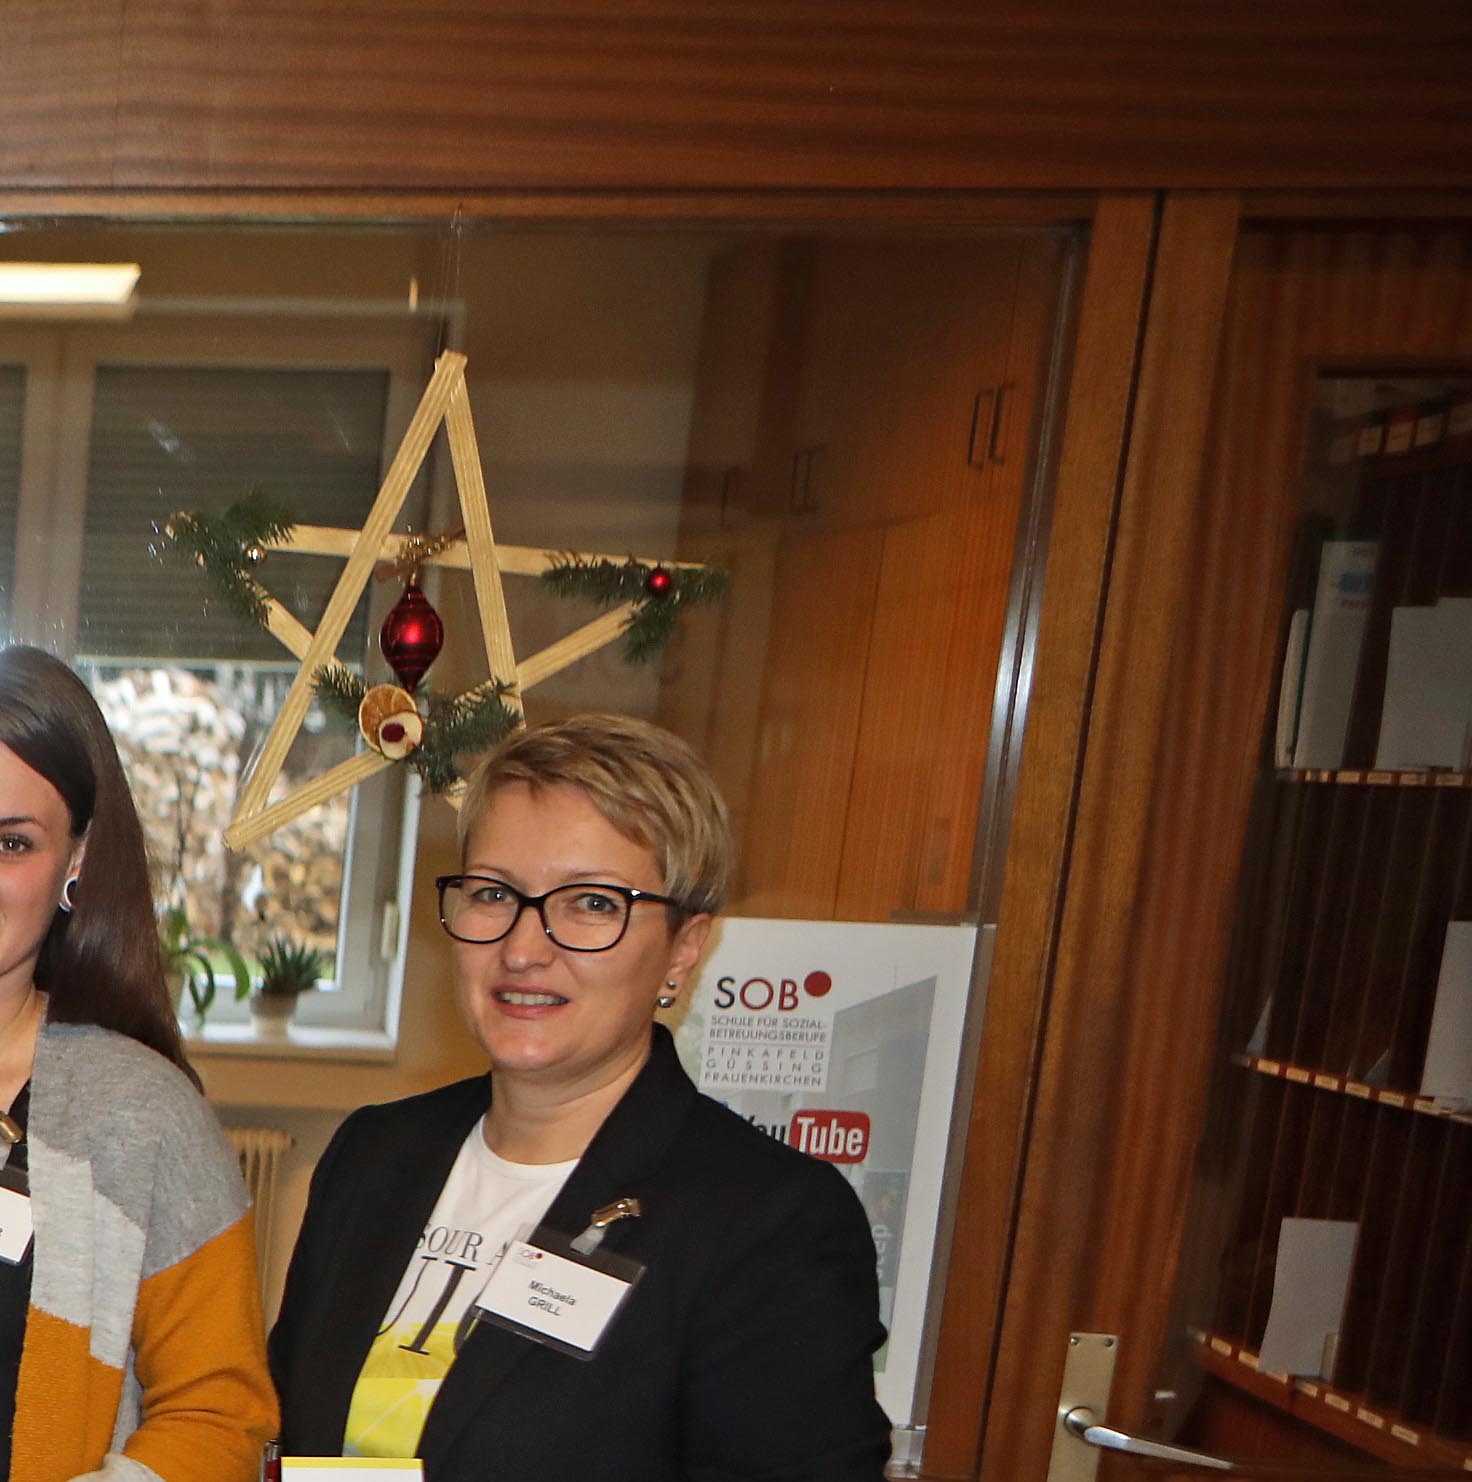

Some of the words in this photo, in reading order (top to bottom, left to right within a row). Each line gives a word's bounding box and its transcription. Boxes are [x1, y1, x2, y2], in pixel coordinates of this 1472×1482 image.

[714, 976, 799, 1011] SOB
[711, 1015, 754, 1026] SCHULE
[757, 1016, 778, 1027] FÜR
[709, 1029, 826, 1043] BETREUUNGSBERUFE
[708, 1047, 824, 1061] PINKAFELD
[706, 1058, 822, 1073] GÜSSING
[704, 1072, 821, 1086] FRAUENKIRCHEN
[528, 1280, 576, 1306] Michaela
[528, 1296, 560, 1316] GRILL
